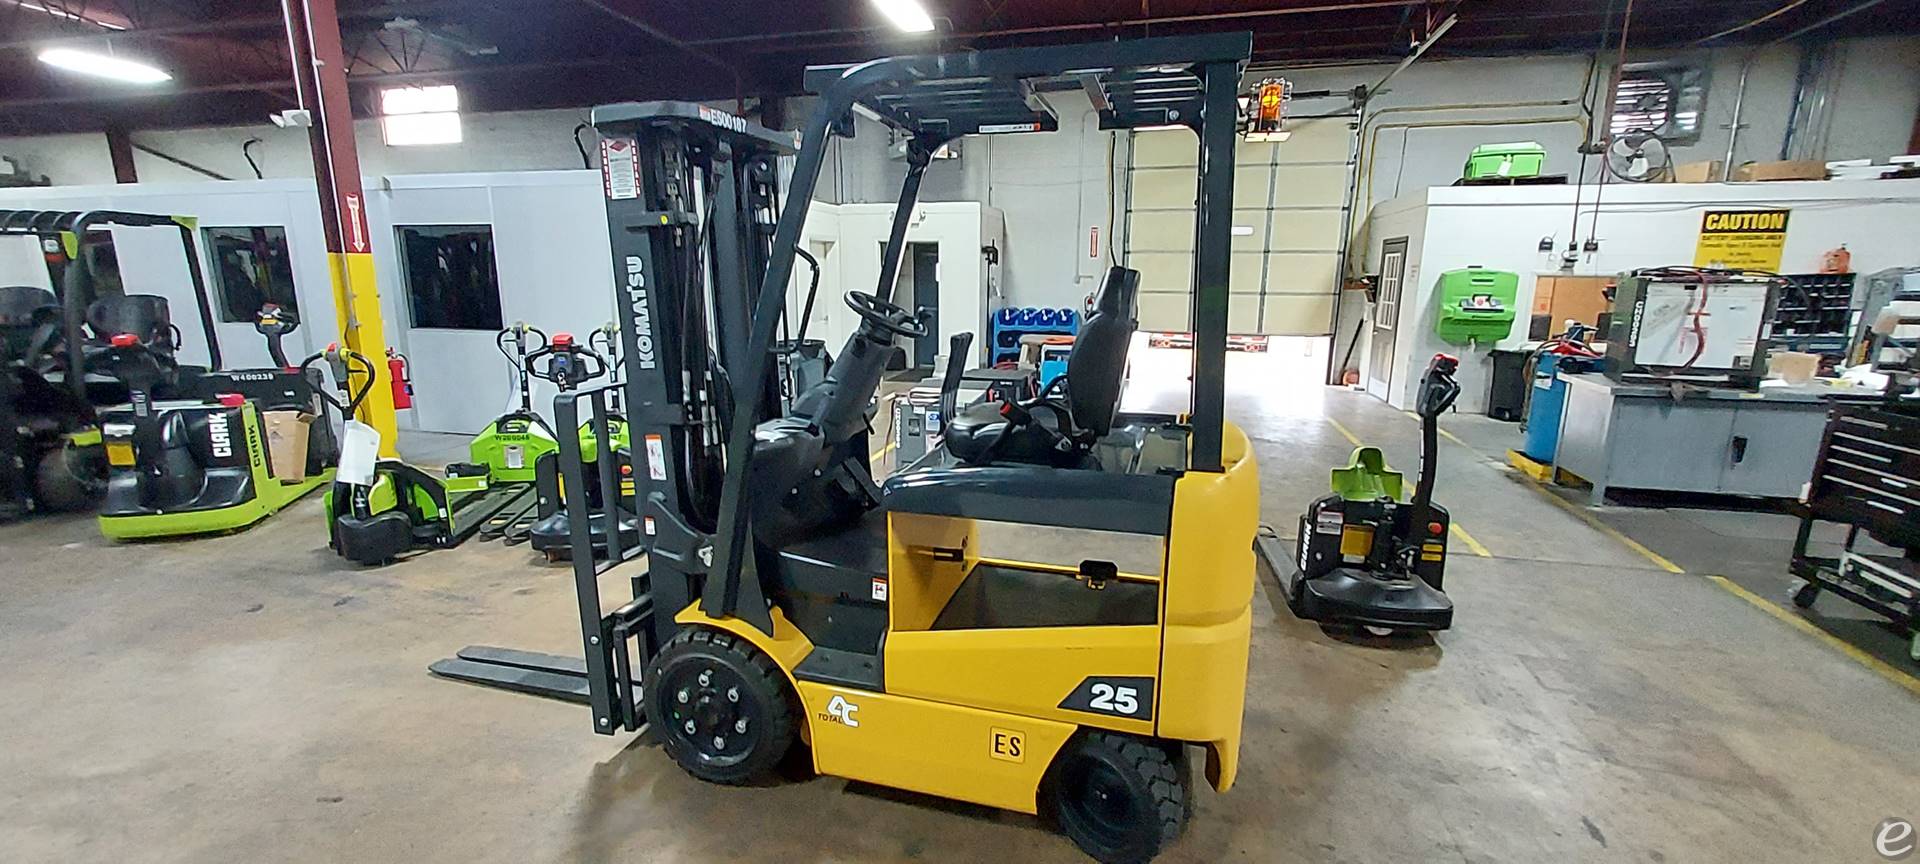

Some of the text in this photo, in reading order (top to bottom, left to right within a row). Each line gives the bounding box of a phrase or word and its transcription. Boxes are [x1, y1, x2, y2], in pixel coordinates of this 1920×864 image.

[1706, 213, 1785, 230] CAUTION
[626, 256, 656, 369] KOMATSU
[208, 412, 232, 458] CLARK
[1089, 683, 1139, 715] 25
[818, 713, 843, 725] TOTAL
[994, 733, 1021, 757] ES
